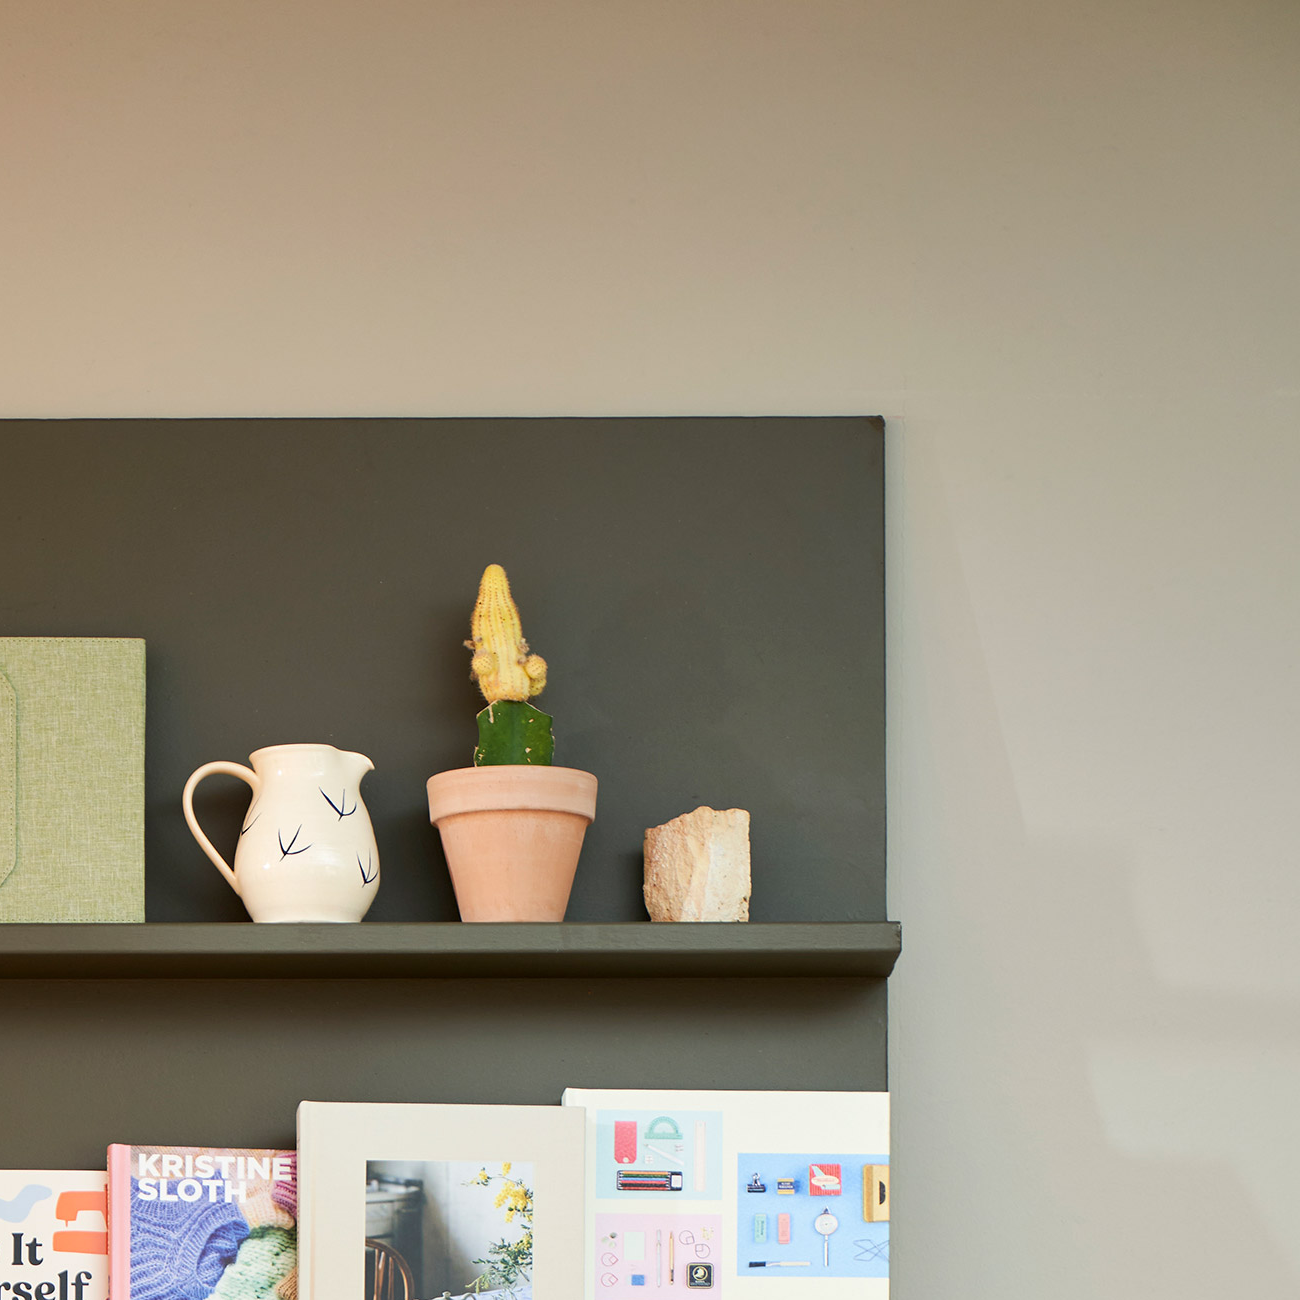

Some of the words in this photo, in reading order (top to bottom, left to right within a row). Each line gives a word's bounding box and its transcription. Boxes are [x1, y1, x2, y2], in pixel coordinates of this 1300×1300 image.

[138, 1153, 292, 1181] KRISTINE
[137, 1178, 247, 1204] SLOTH
[11, 1232, 44, 1267] It
